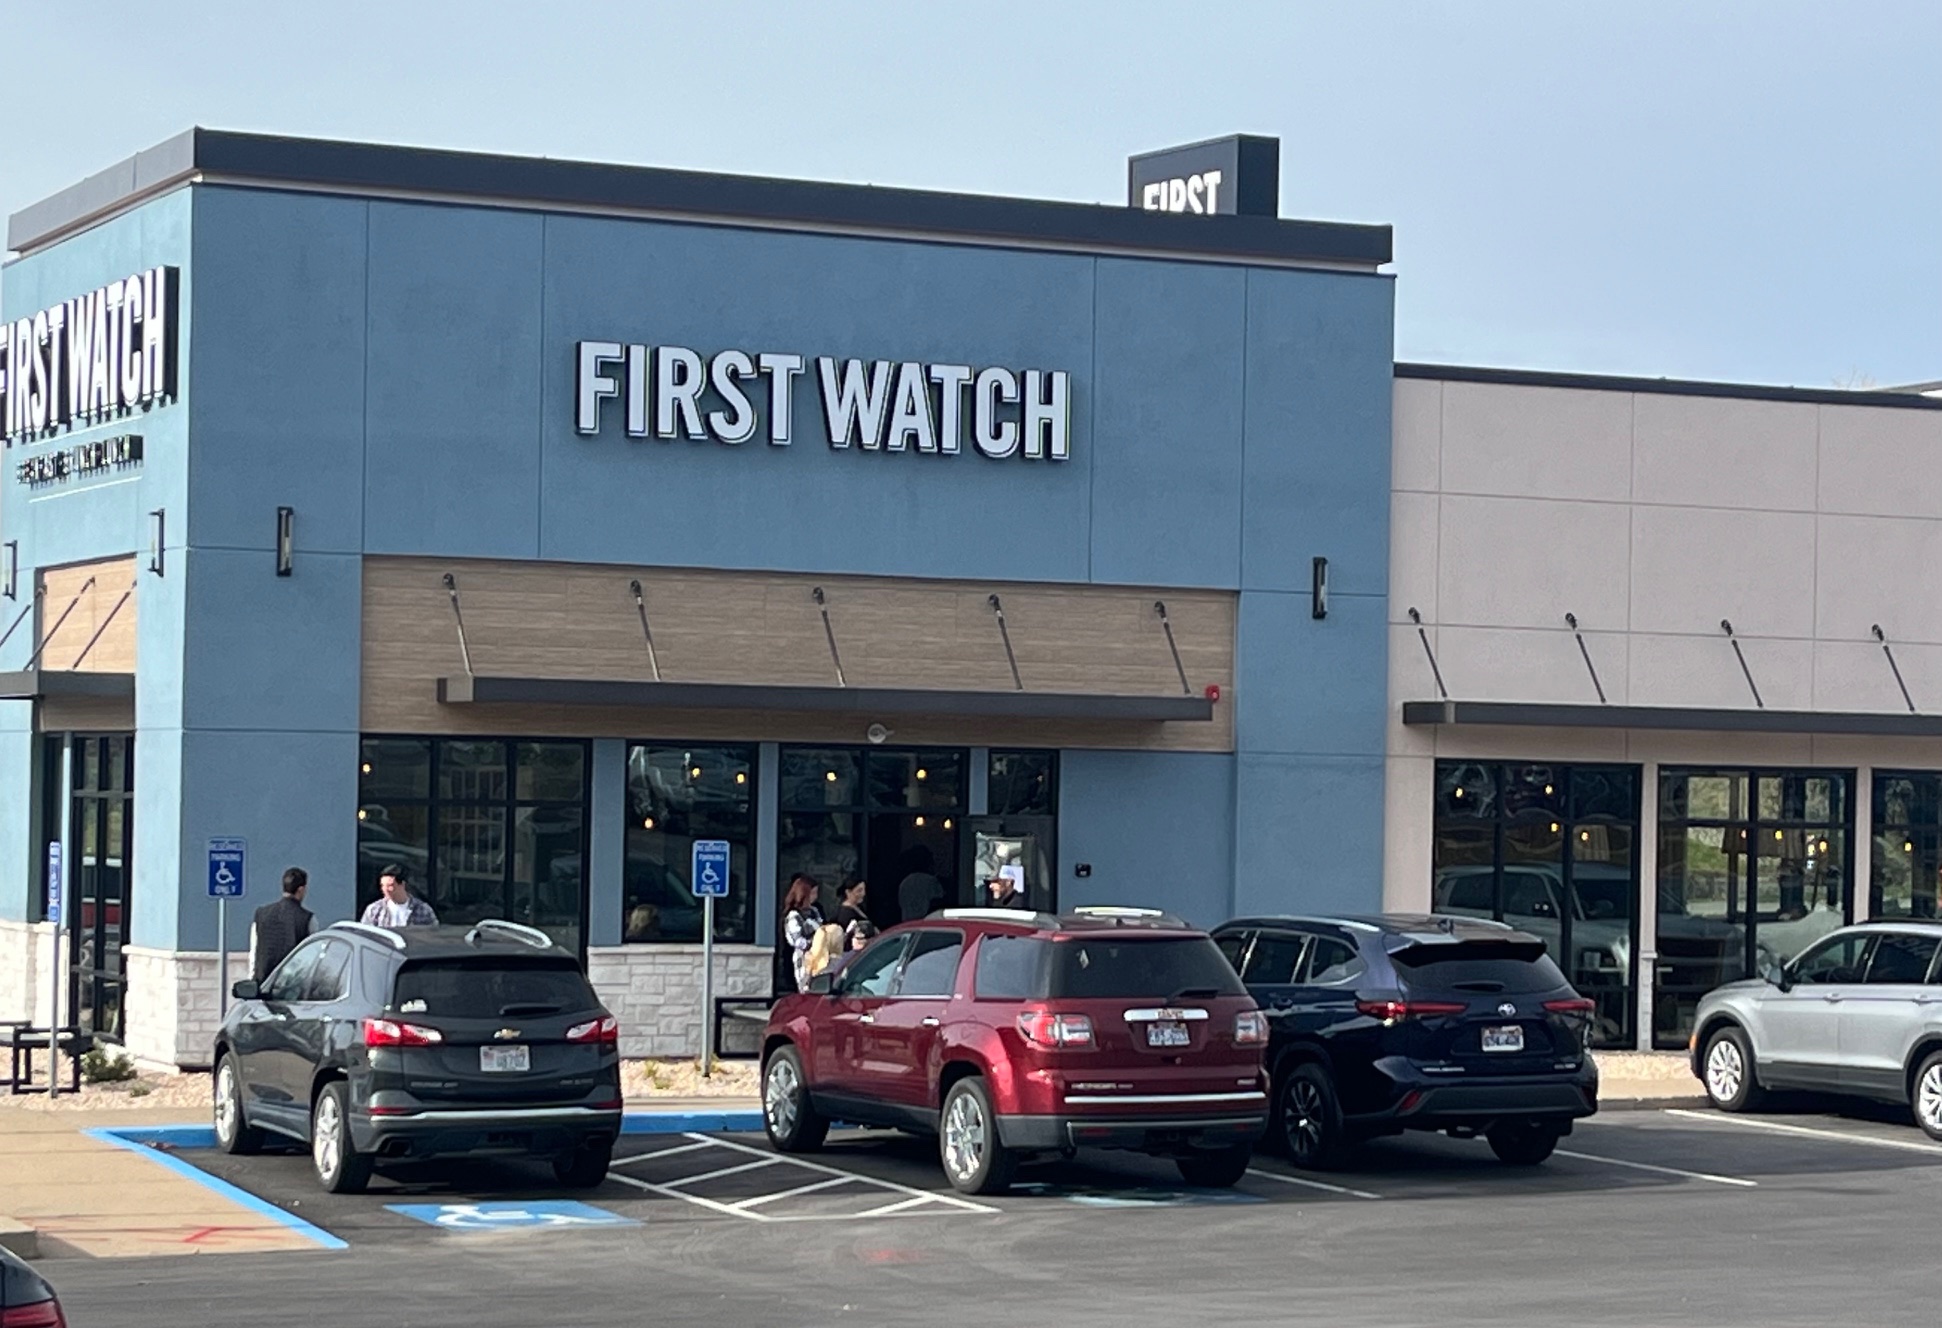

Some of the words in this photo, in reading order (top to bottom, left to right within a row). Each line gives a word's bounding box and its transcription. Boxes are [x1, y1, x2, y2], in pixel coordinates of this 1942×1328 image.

[67, 266, 174, 422] WATCH
[577, 341, 806, 446] FIRST
[817, 356, 1071, 461] WATCH
